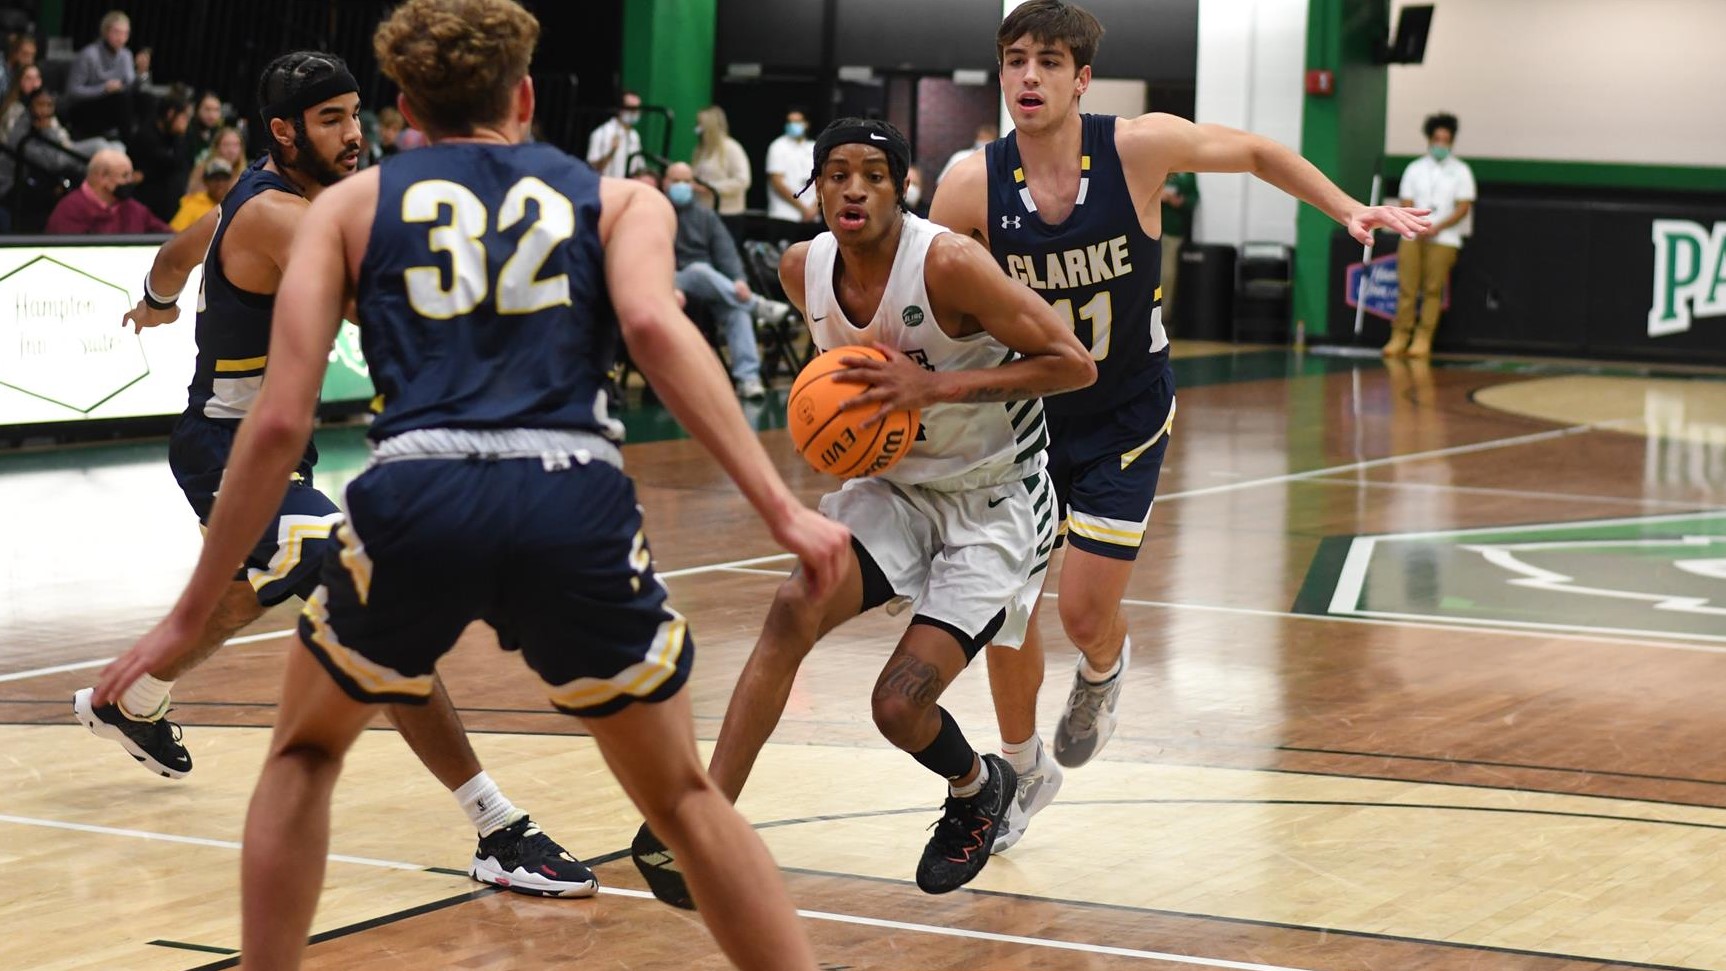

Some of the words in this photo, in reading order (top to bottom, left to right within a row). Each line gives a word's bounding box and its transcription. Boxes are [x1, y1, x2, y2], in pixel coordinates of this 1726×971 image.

[401, 176, 576, 320] 32
[1006, 234, 1133, 290] CLARKE
[15, 292, 97, 324] Hampton
[855, 428, 906, 478] Wil
